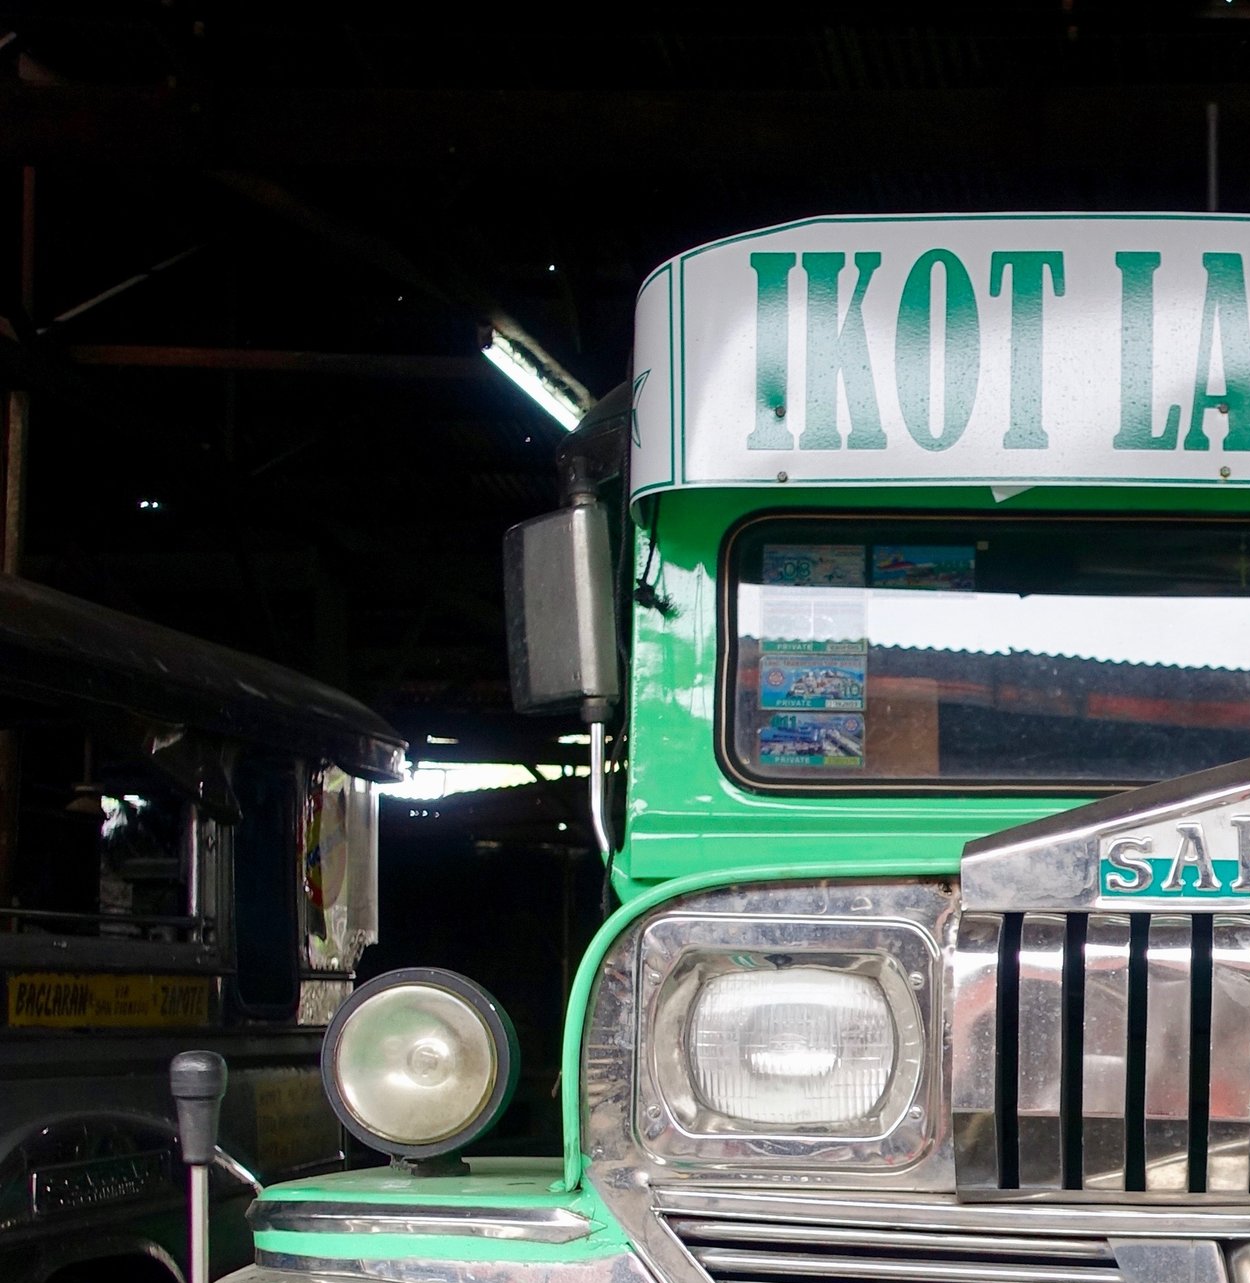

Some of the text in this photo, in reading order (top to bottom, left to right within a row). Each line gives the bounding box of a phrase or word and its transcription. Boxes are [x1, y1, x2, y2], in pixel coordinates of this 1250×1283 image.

[745, 247, 1065, 452] IKOT
[775, 699, 812, 708] PRIVATE
[774, 756, 811, 765] PRIVATE
[15, 982, 90, 1017] BACLARAN
